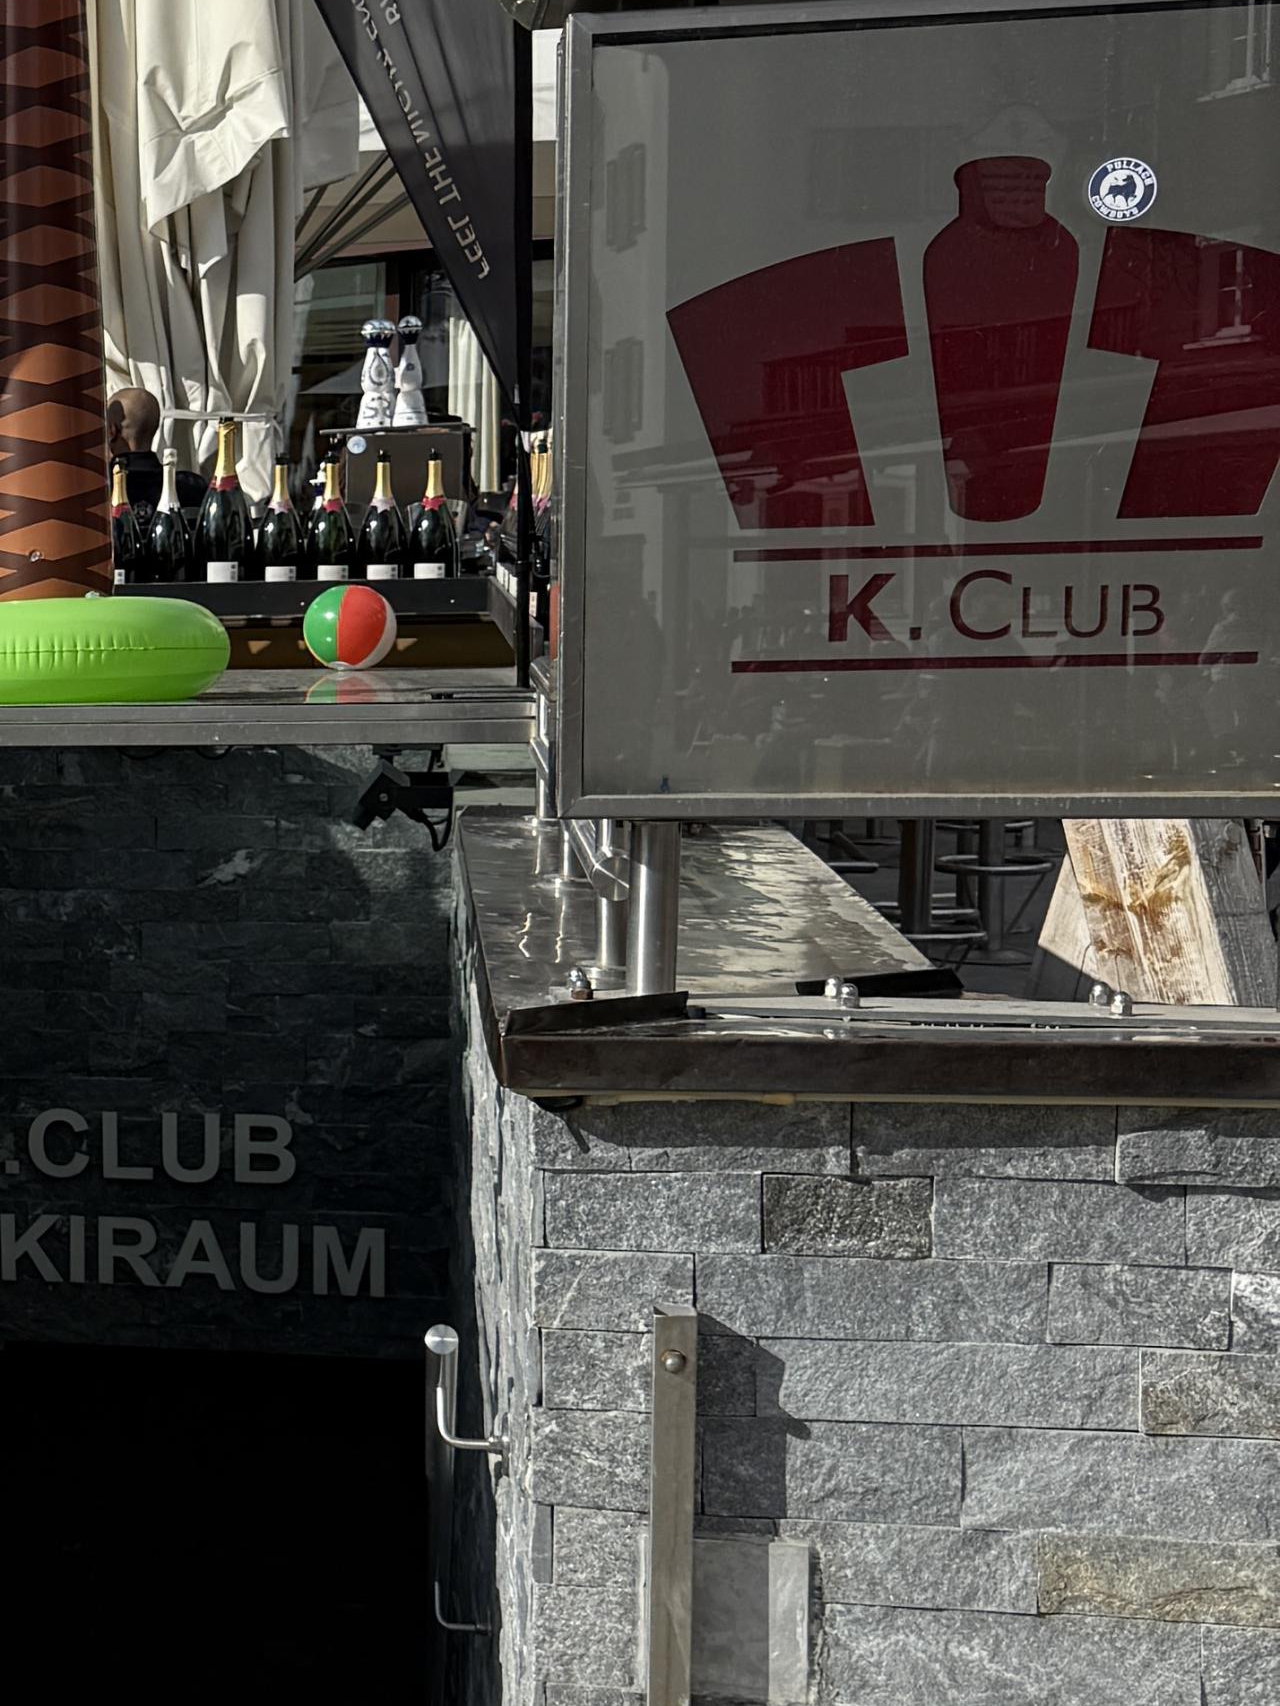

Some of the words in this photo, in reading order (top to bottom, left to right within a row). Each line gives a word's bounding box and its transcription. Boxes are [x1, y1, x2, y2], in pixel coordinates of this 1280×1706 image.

[1106, 159, 1154, 186] PULLACH
[828, 572, 922, 645] K.
[948, 568, 1165, 640] CLUB
